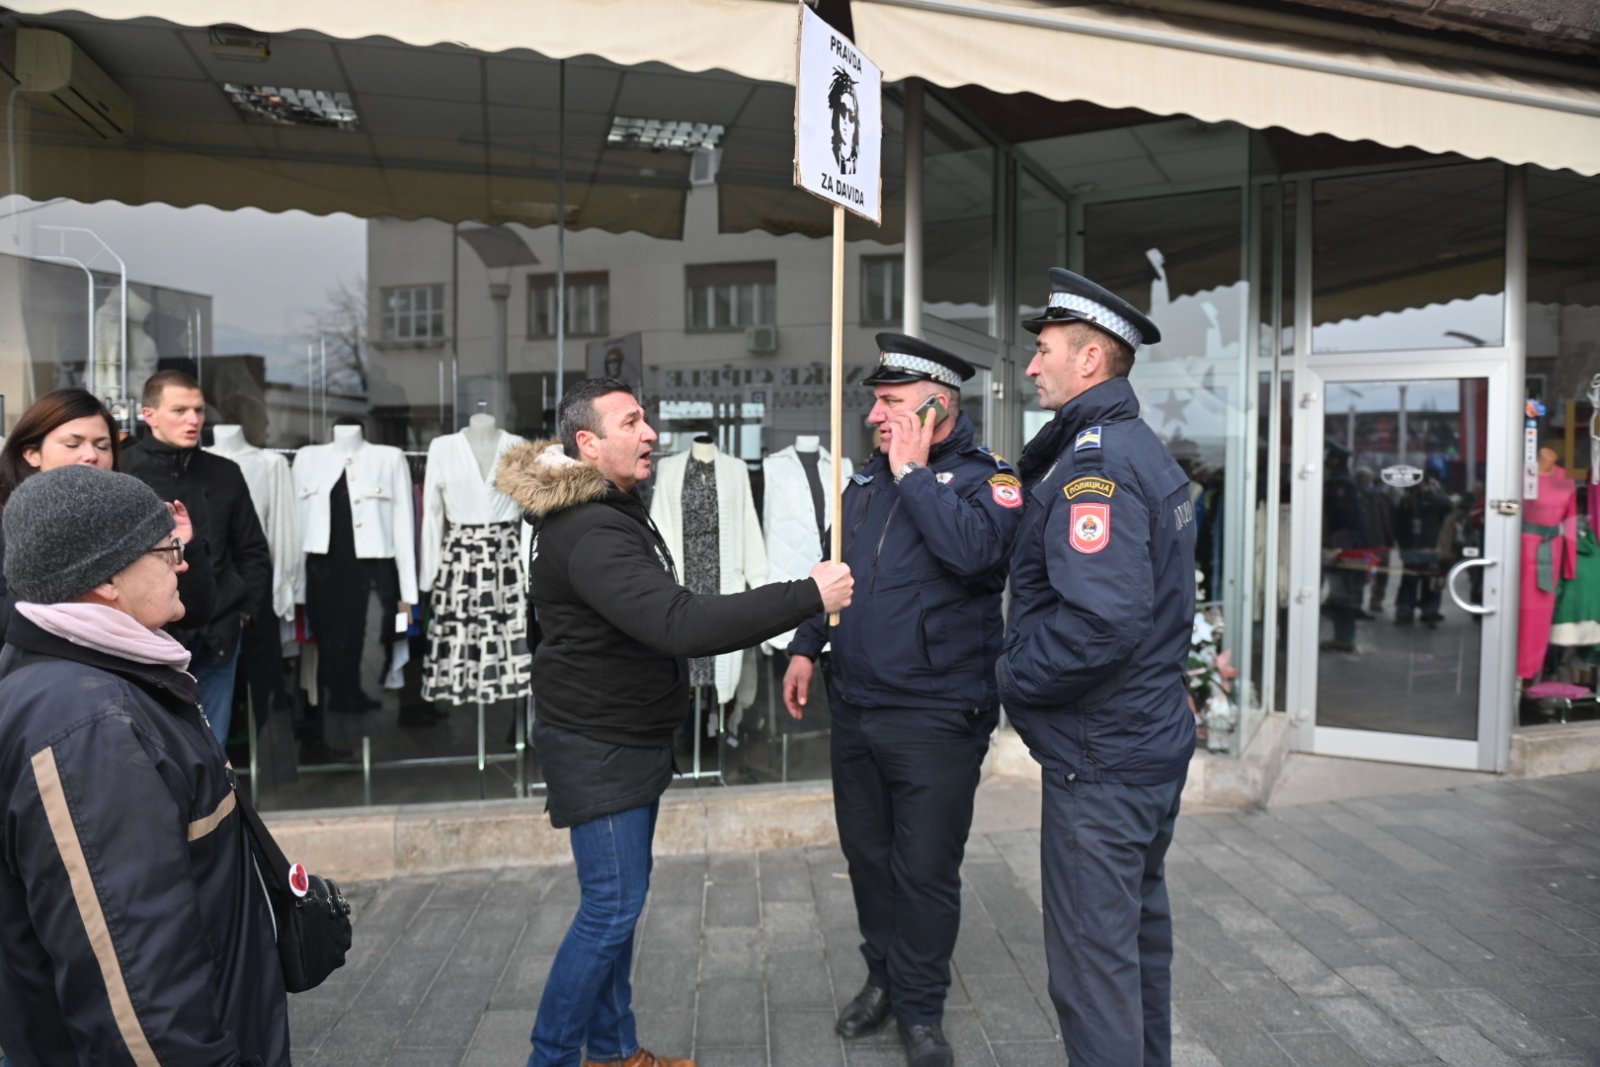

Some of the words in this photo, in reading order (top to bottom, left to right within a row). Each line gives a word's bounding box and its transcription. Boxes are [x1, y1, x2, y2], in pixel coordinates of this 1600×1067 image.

[830, 34, 862, 74] PRAVDA
[821, 172, 834, 192] ZA
[835, 179, 864, 207] DAVIDA
